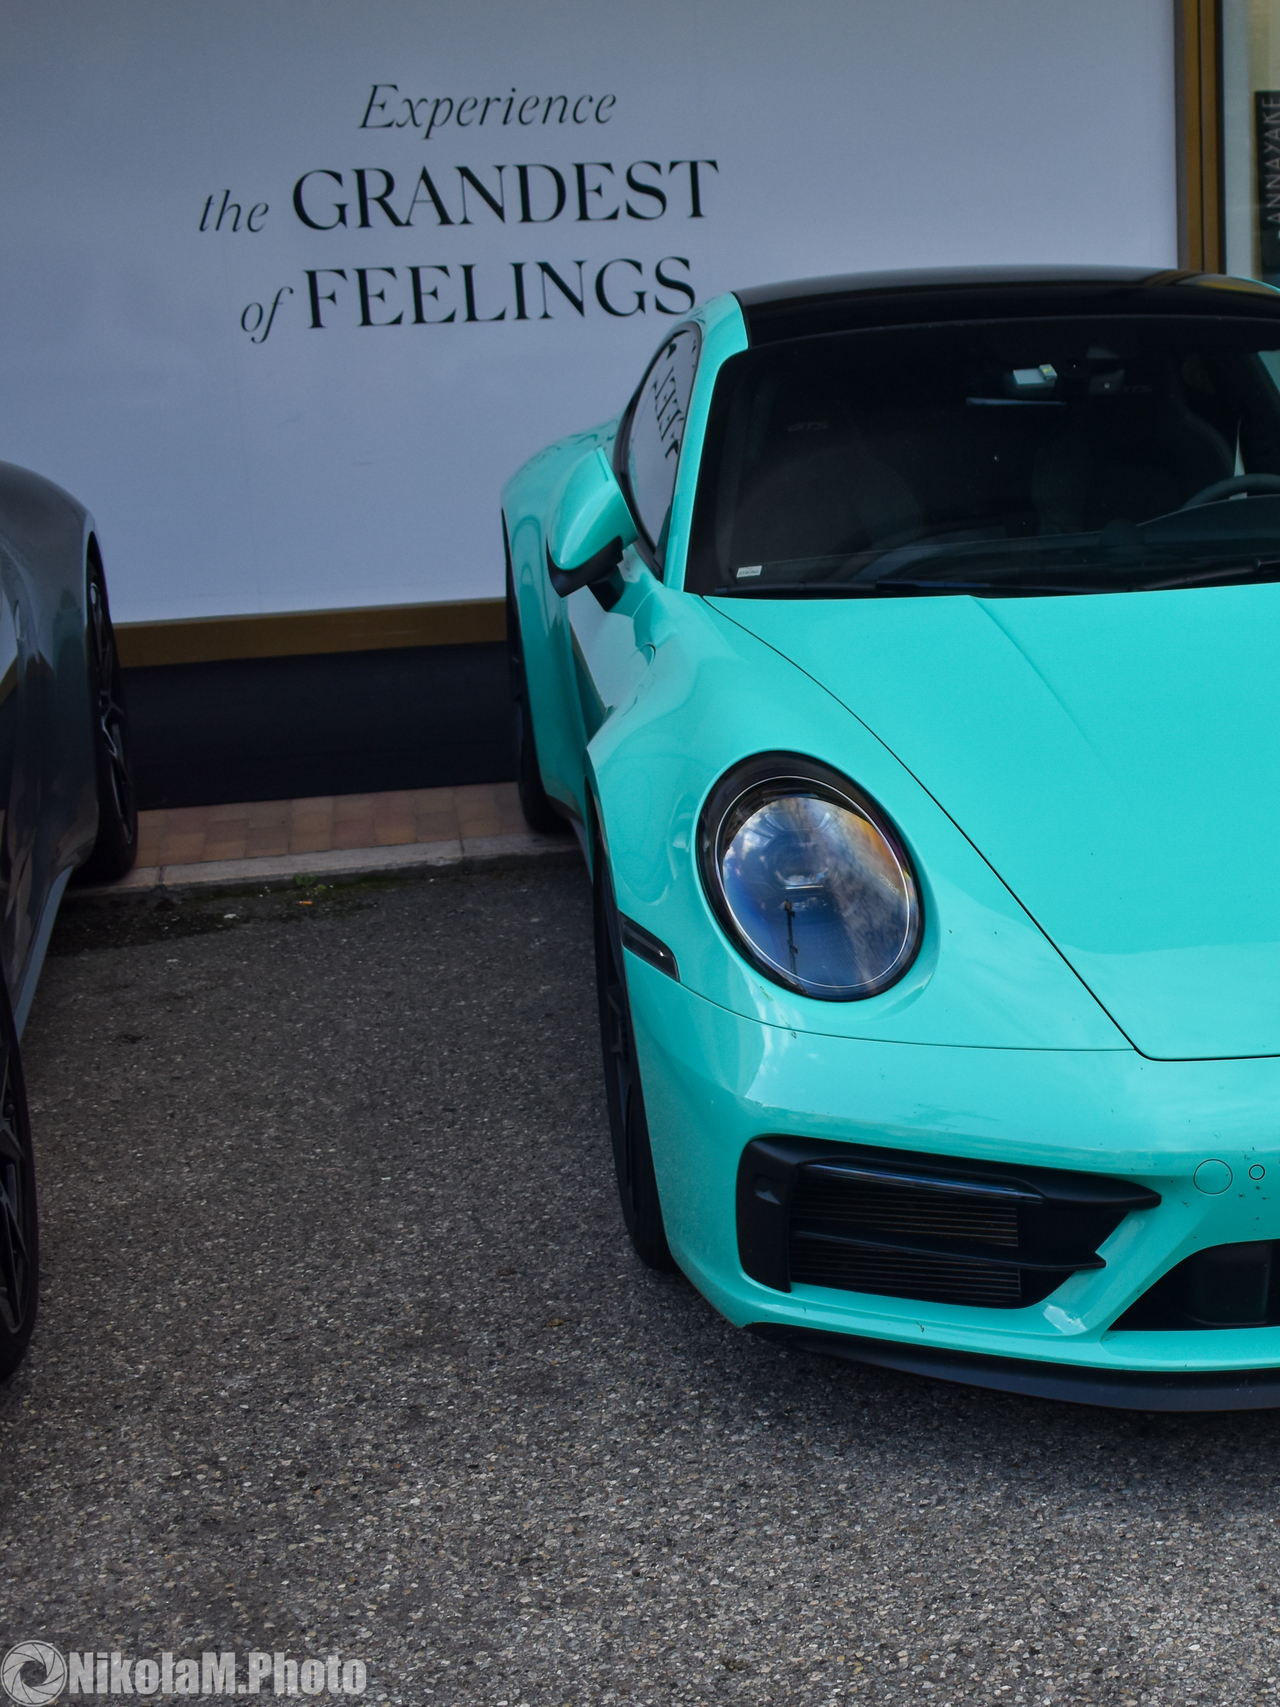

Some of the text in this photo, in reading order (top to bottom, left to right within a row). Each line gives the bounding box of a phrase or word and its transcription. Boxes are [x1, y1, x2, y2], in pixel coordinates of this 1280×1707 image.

[358, 84, 617, 140] Experience
[199, 159, 719, 233] the GRANDEST
[240, 256, 697, 344] of FEELINGS
